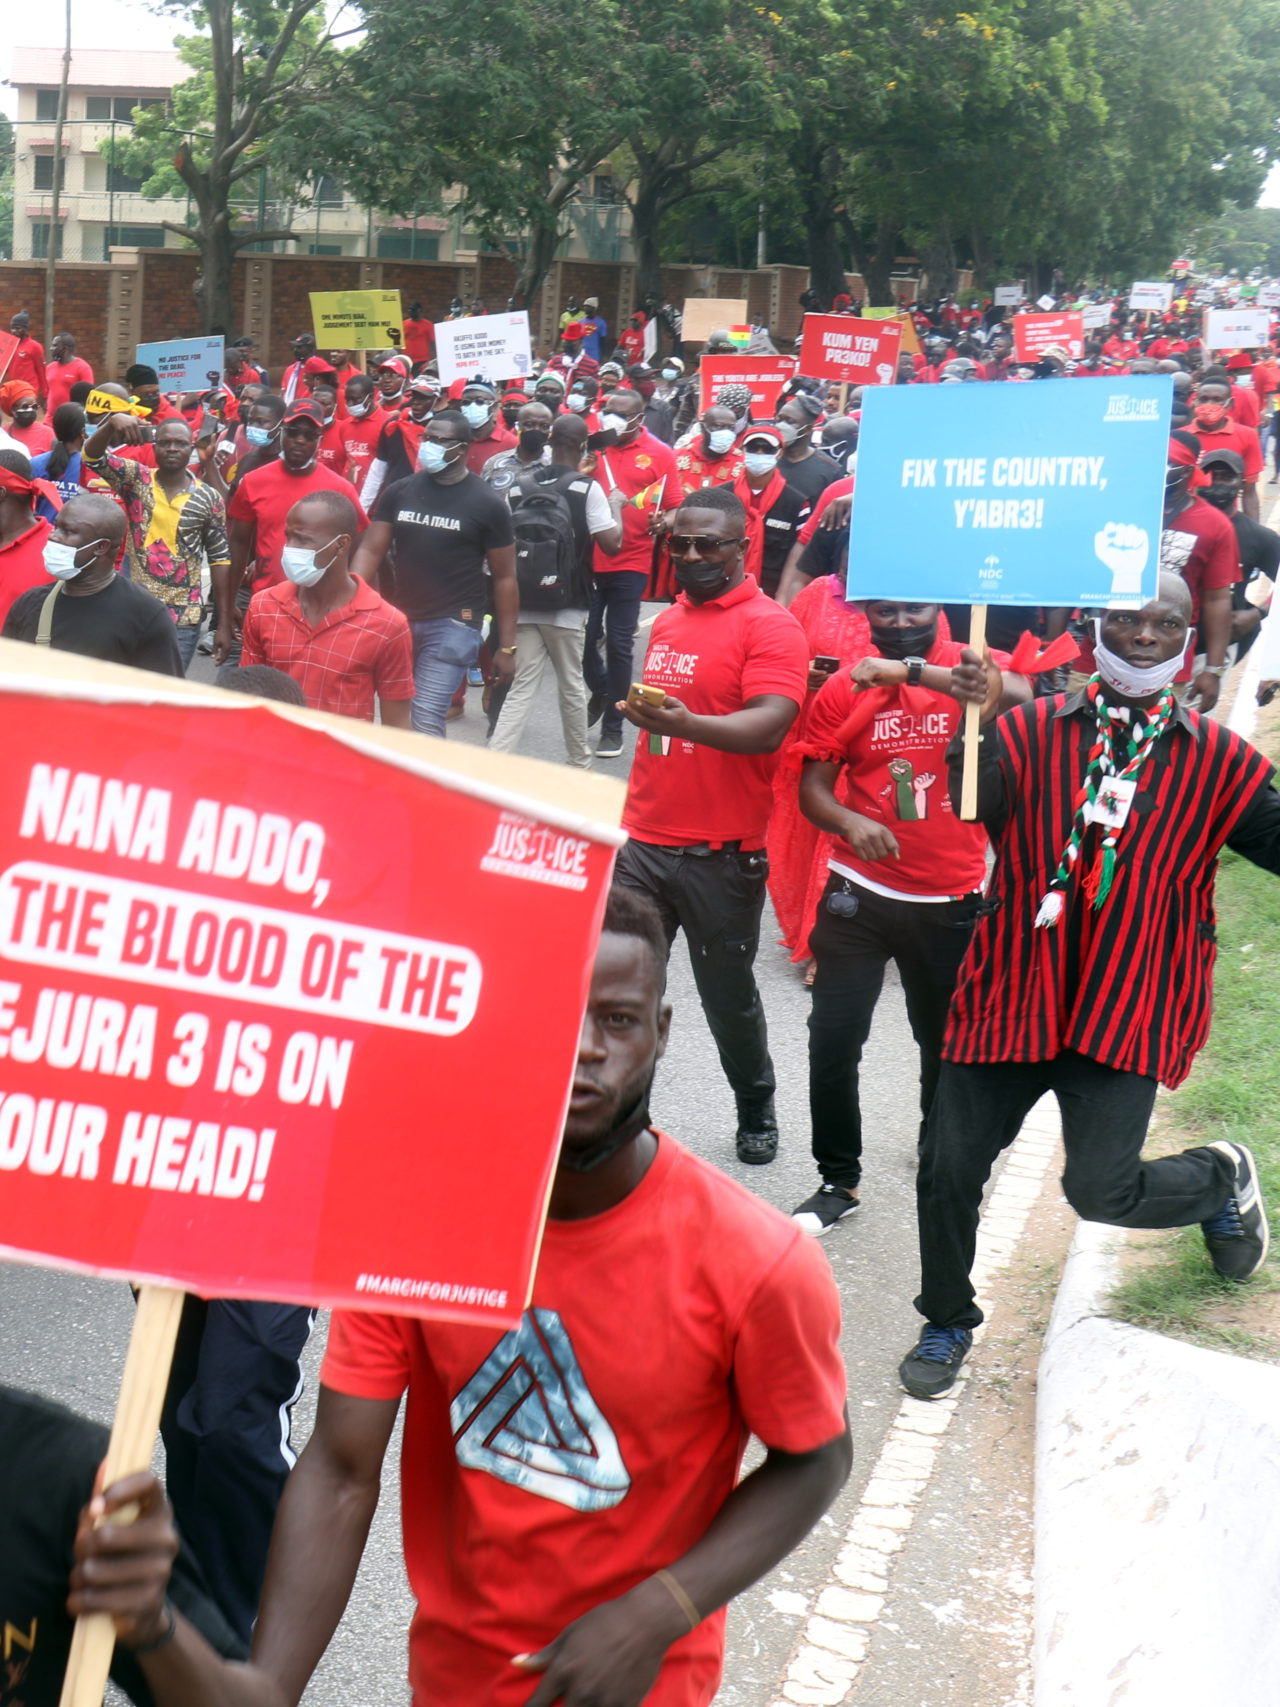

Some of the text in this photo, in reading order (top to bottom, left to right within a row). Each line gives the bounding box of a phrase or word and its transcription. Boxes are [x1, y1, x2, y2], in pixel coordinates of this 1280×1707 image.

[822, 332, 879, 352] KUM YEN
[168, 354, 189, 362] JUSTICE
[824, 348, 872, 367] PR3KO!
[87, 396, 112, 410] NA
[901, 456, 1108, 491] FIX THE COUNTRY,
[397, 510, 461, 531] BIELLA ITALIA
[954, 498, 1045, 529] Y'ABR3!
[979, 568, 1003, 579] NDC
[645, 652, 699, 675] JUSTICE
[872, 714, 949, 741] JUSTICE
[20, 762, 331, 908] NANA ADDO,
[488, 823, 591, 874] JUSTICE
[8, 874, 470, 1022] THE BLOOD OF THE
[166, 1011, 210, 1088] 3
[214, 1020, 272, 1098] IS
[277, 1030, 354, 1110] ON
[112, 1110, 277, 1202] HEAD!
[355, 1272, 508, 1308] #MARCHFORJUSTICE
